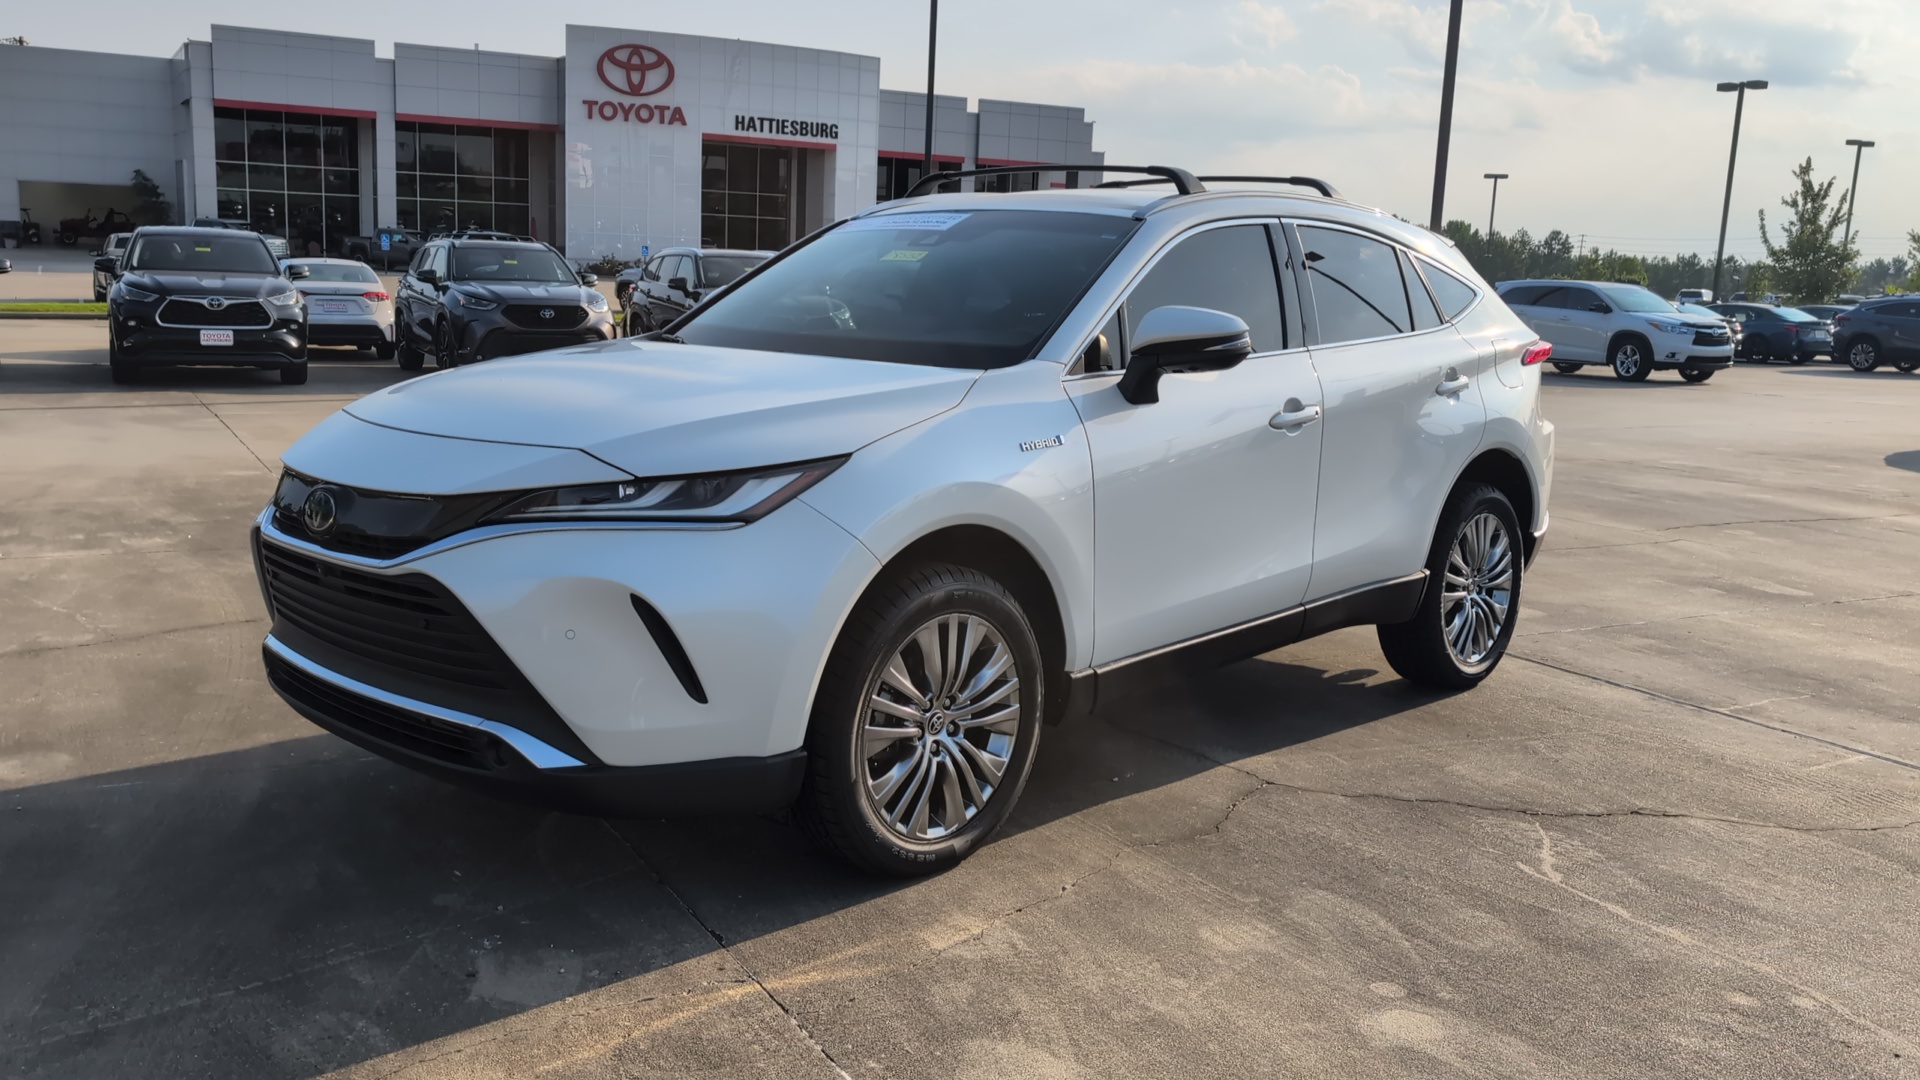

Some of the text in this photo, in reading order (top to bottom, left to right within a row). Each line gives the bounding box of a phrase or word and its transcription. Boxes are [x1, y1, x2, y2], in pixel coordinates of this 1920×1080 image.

[582, 100, 687, 126] TOYOTA
[735, 115, 839, 139] HATTIESBURG
[1019, 437, 1060, 452] HYBRID
